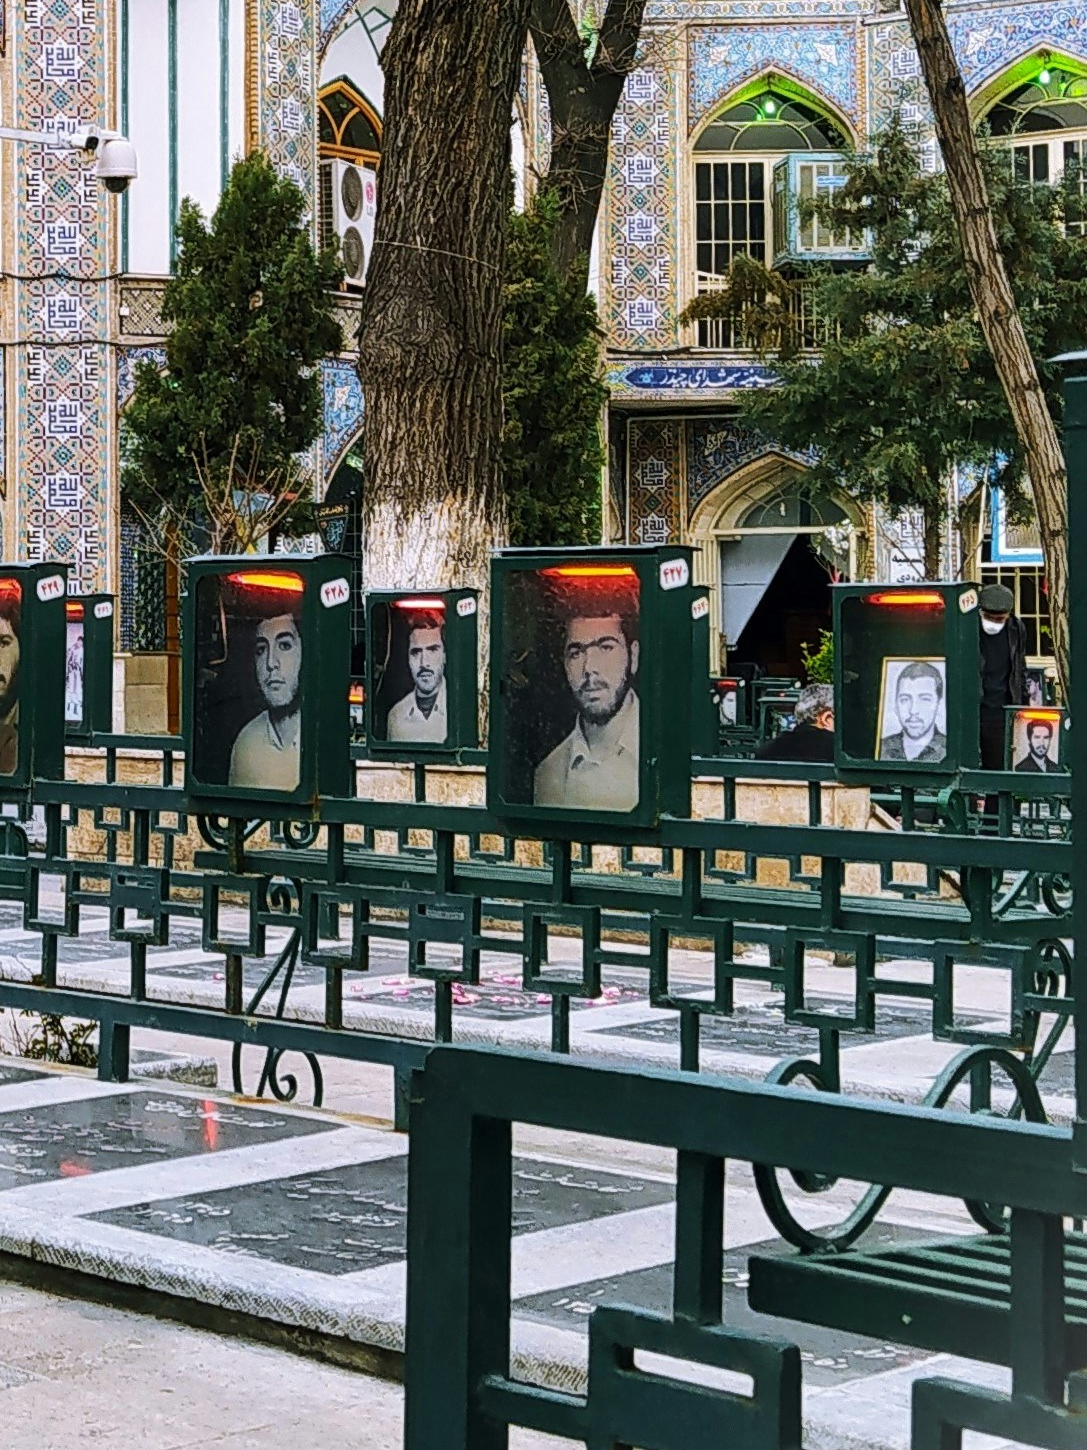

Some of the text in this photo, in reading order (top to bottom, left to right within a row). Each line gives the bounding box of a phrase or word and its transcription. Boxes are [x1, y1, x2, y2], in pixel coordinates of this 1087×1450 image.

[663, 565, 682, 585] ۴۲۷
[41, 576, 61, 596] ۴۲۹
[324, 584, 344, 602] ۴۲۸
